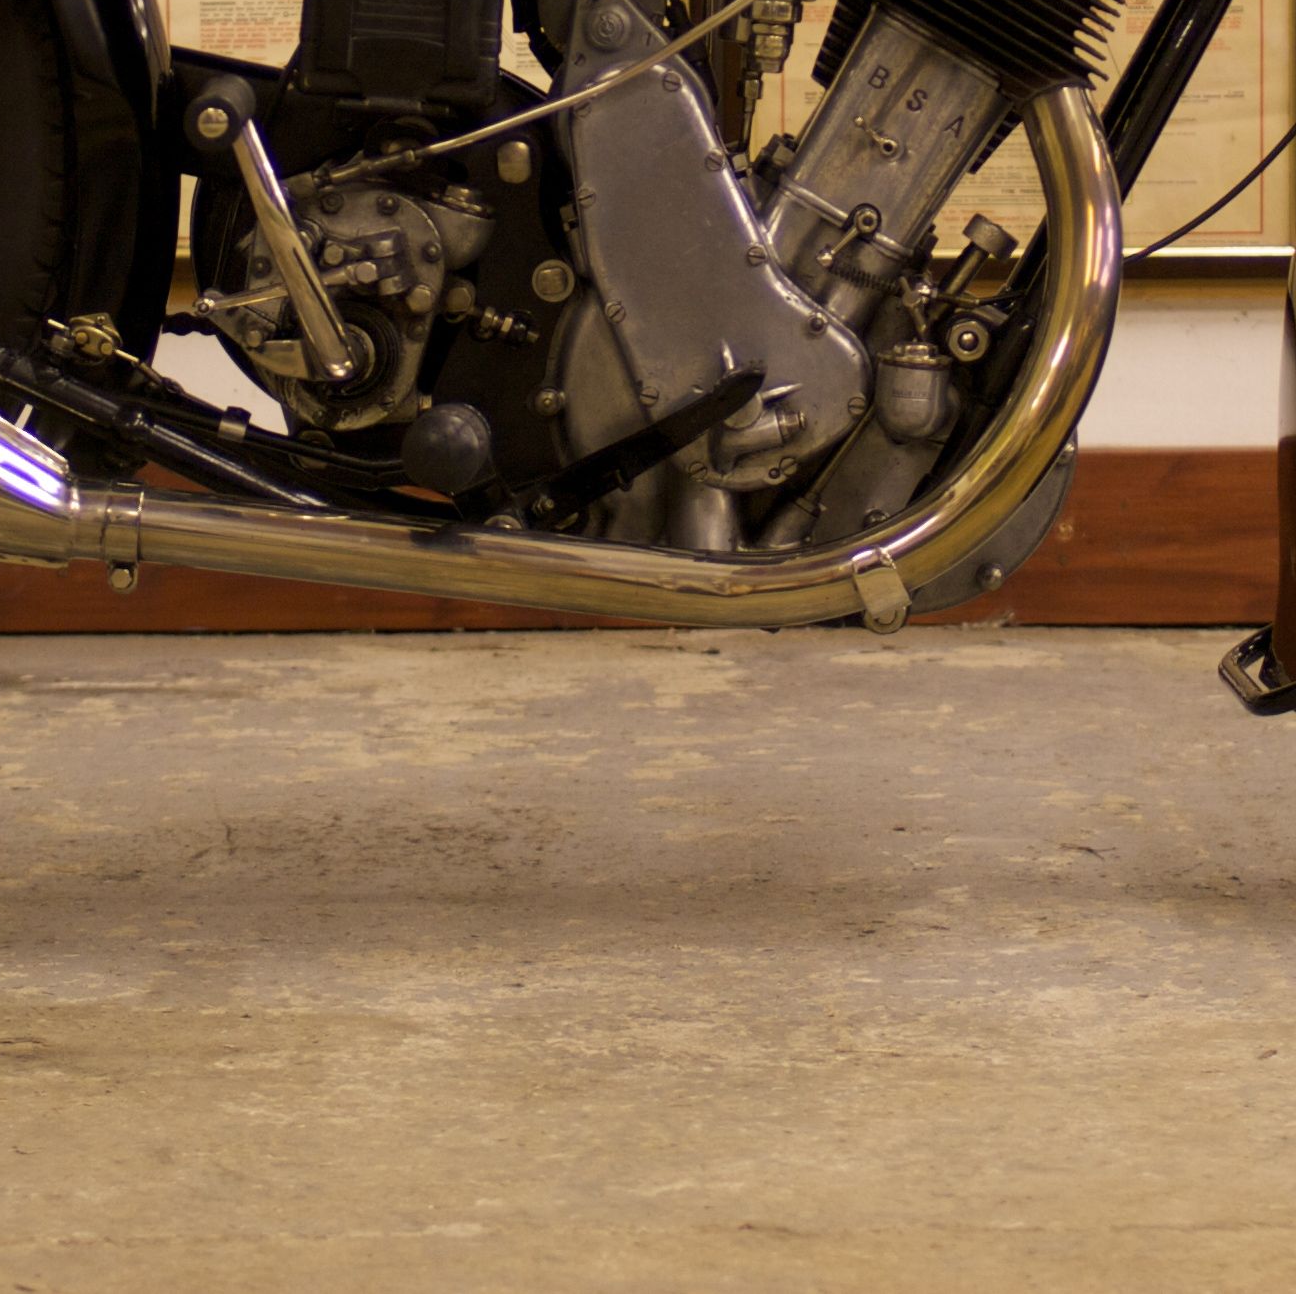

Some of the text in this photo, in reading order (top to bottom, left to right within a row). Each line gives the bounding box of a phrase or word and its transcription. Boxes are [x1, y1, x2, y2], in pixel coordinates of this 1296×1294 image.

[867, 66, 964, 140] B S A
